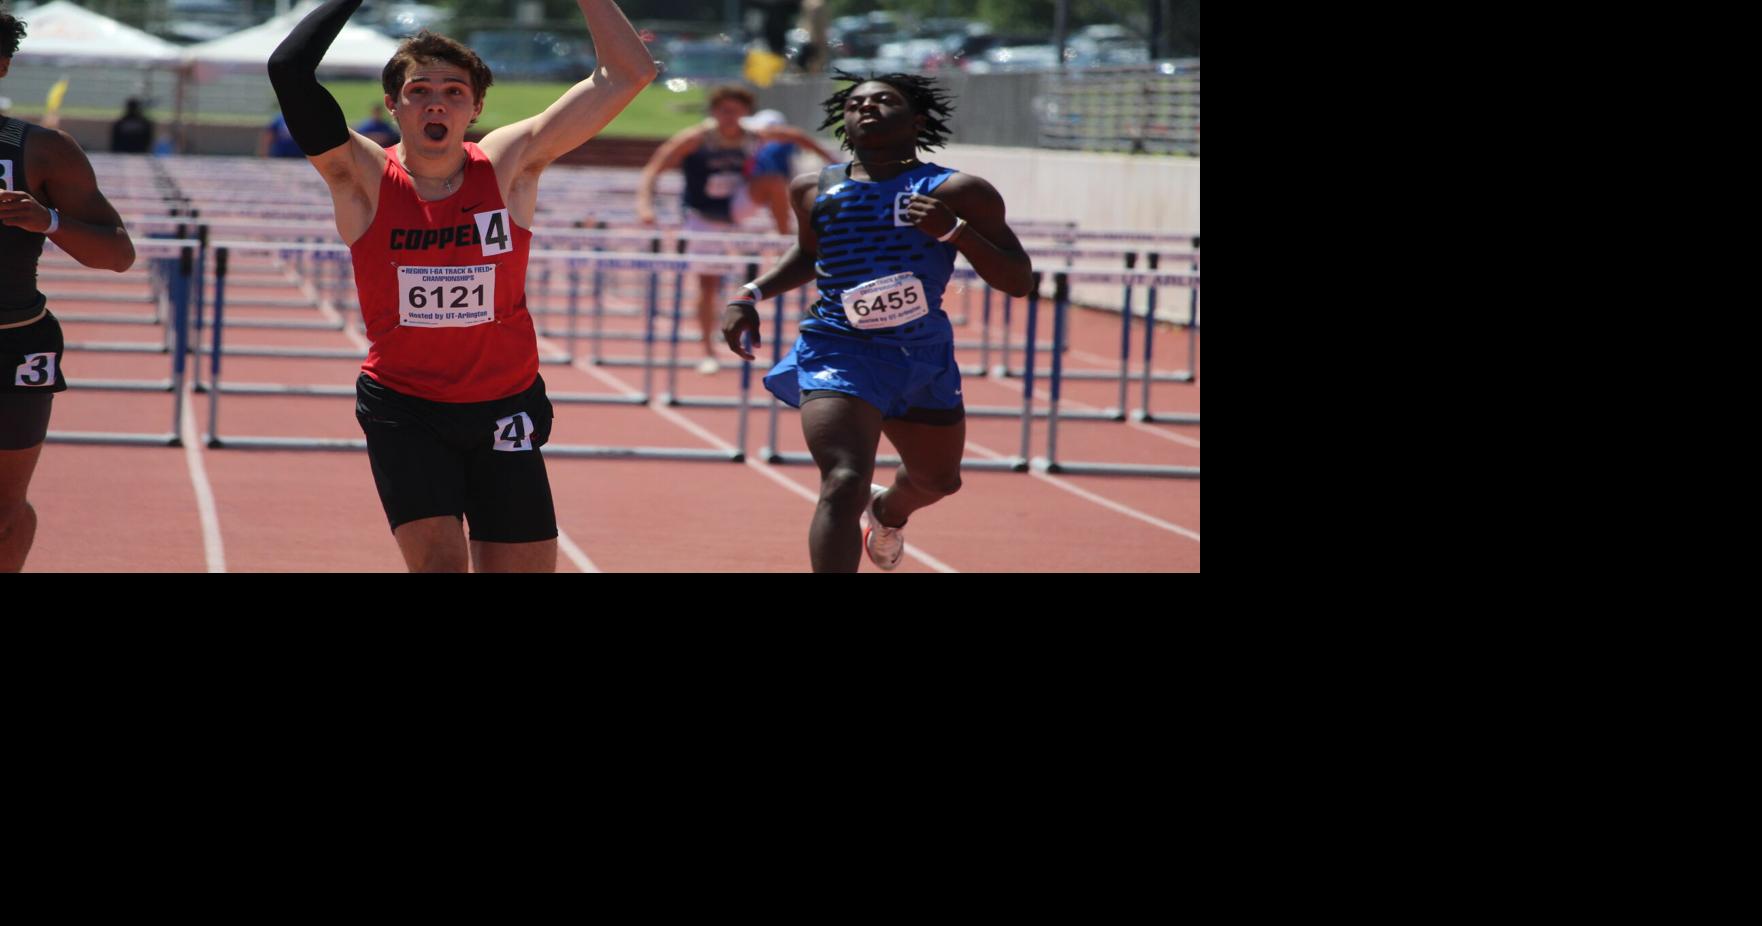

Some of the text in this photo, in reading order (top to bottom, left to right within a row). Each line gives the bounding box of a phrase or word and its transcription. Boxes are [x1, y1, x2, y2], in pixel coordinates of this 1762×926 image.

[485, 212, 508, 250] 4
[408, 284, 484, 308] 6121
[853, 286, 918, 317] 6455
[434, 312, 444, 320] by
[21, 355, 48, 385] 3
[500, 415, 525, 448] 4
